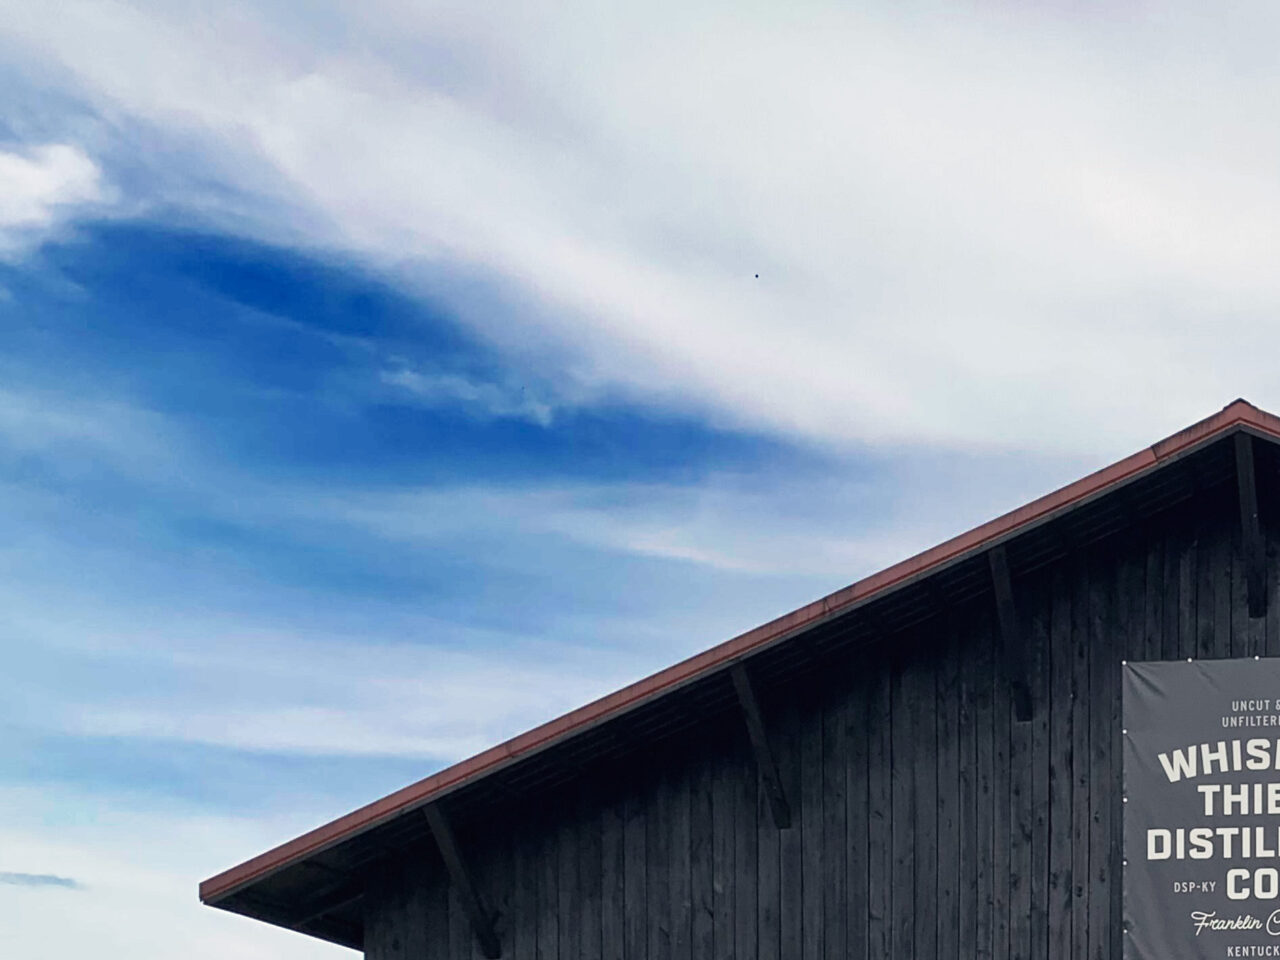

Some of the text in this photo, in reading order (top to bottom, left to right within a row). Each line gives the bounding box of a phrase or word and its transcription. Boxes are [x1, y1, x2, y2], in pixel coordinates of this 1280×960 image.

[1231, 700, 1271, 712] UNCUT
[1173, 881, 1217, 893] DSP-KY
[1190, 910, 1263, 936] Franklin
